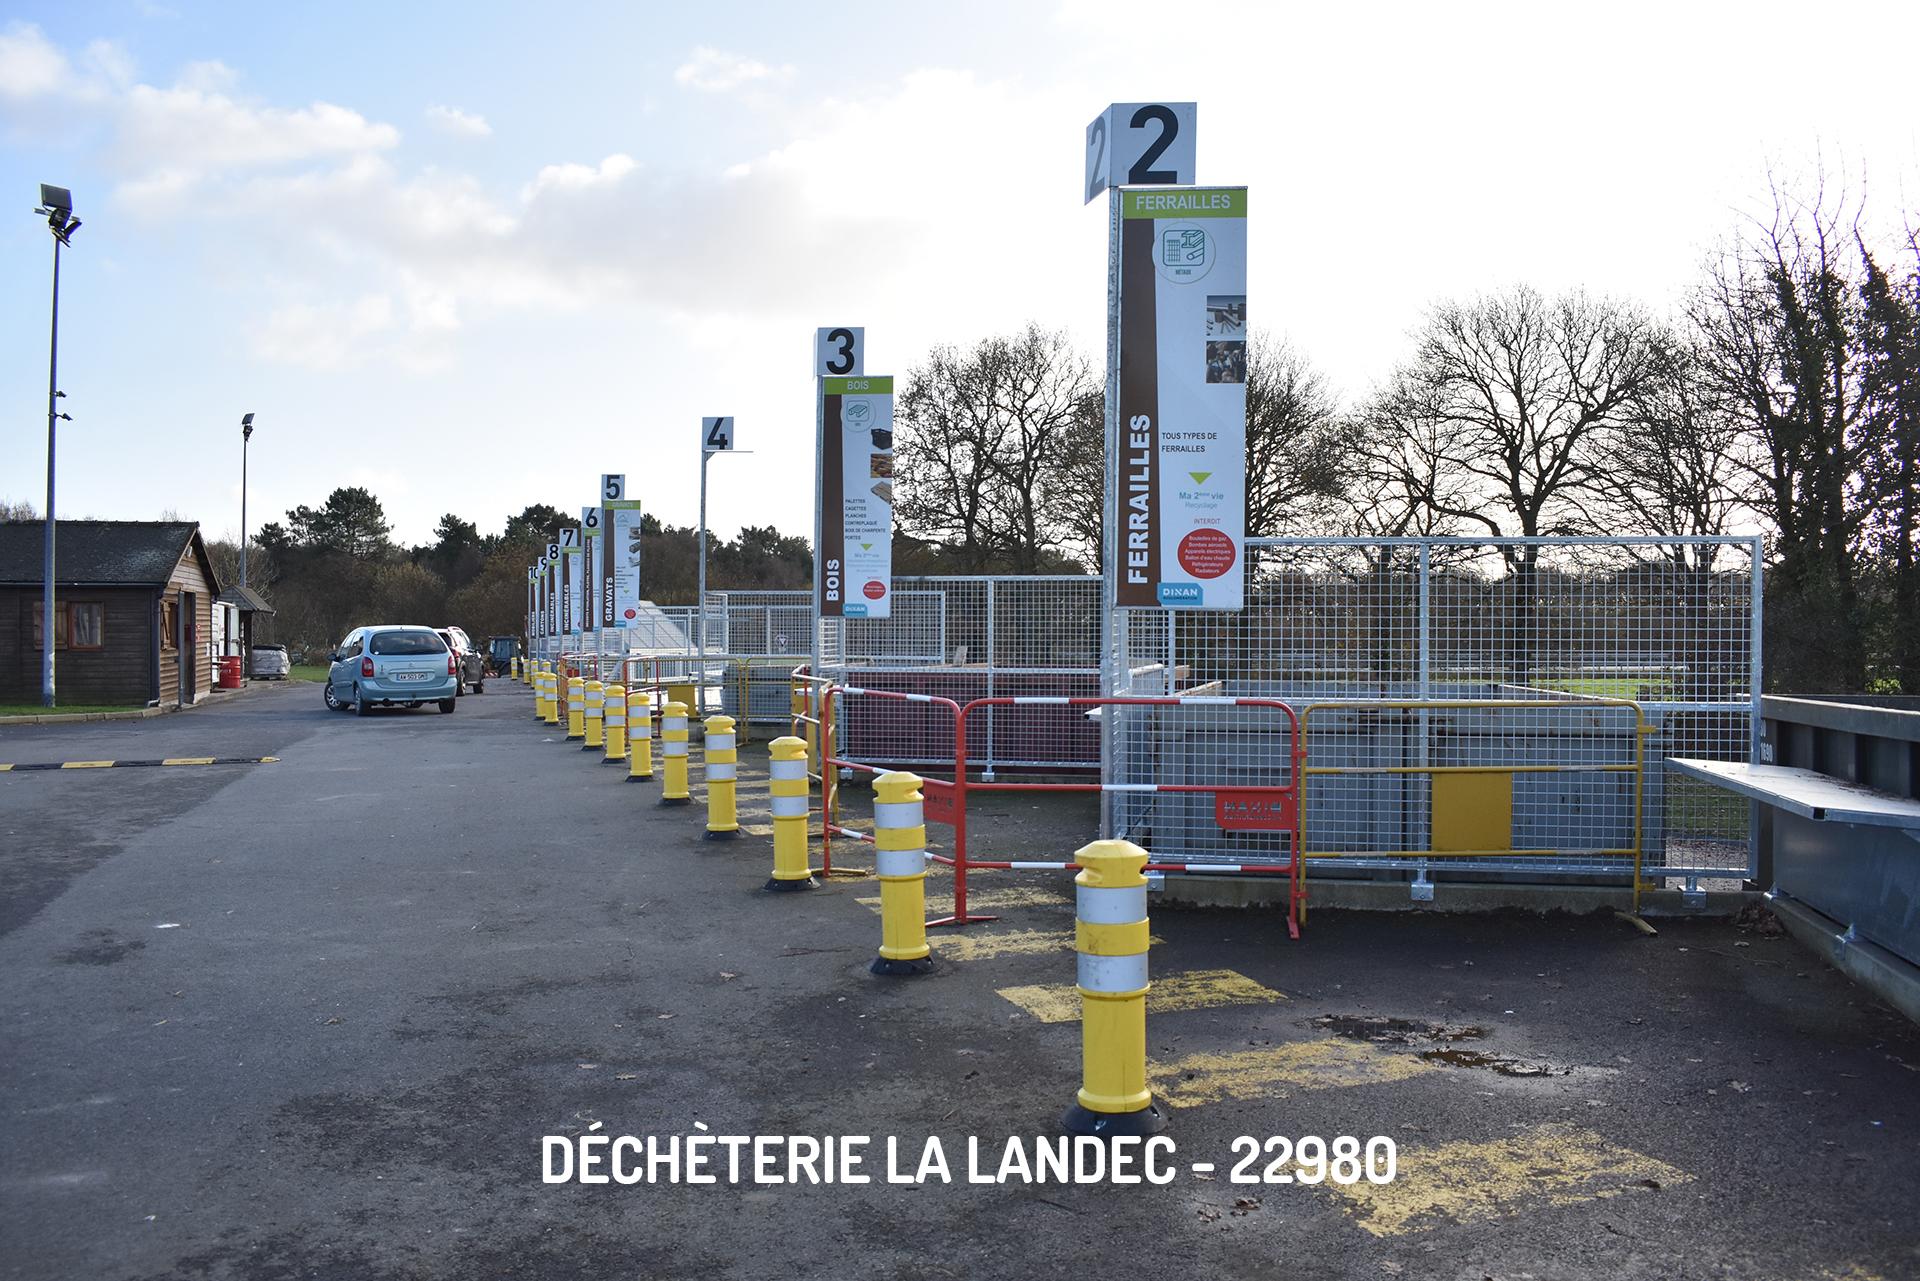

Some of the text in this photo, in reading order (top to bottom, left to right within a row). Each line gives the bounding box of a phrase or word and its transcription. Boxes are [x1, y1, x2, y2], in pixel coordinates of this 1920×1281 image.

[1128, 104, 1179, 185] 2
[1090, 115, 1107, 200] 2
[1136, 194, 1231, 210] FERRAILLES
[826, 328, 855, 375] 3
[847, 380, 869, 390] BOIS
[707, 417, 728, 450] 4
[1161, 432, 1217, 440] TOUS TYPES DE
[1161, 445, 1206, 453] FERRAILLES
[605, 474, 620, 500] 5
[1179, 492, 1192, 500] Ma
[1211, 491, 1224, 500] vie
[1128, 414, 1151, 584] FERRAILLES
[585, 507, 598, 528] 6
[563, 529, 574, 547] 7
[549, 544, 559, 560] 8
[540, 557, 547, 571] 9
[826, 559, 840, 601] BOIS
[605, 577, 614, 622] GRAVATS
[1162, 588, 1198, 596] DINAN
